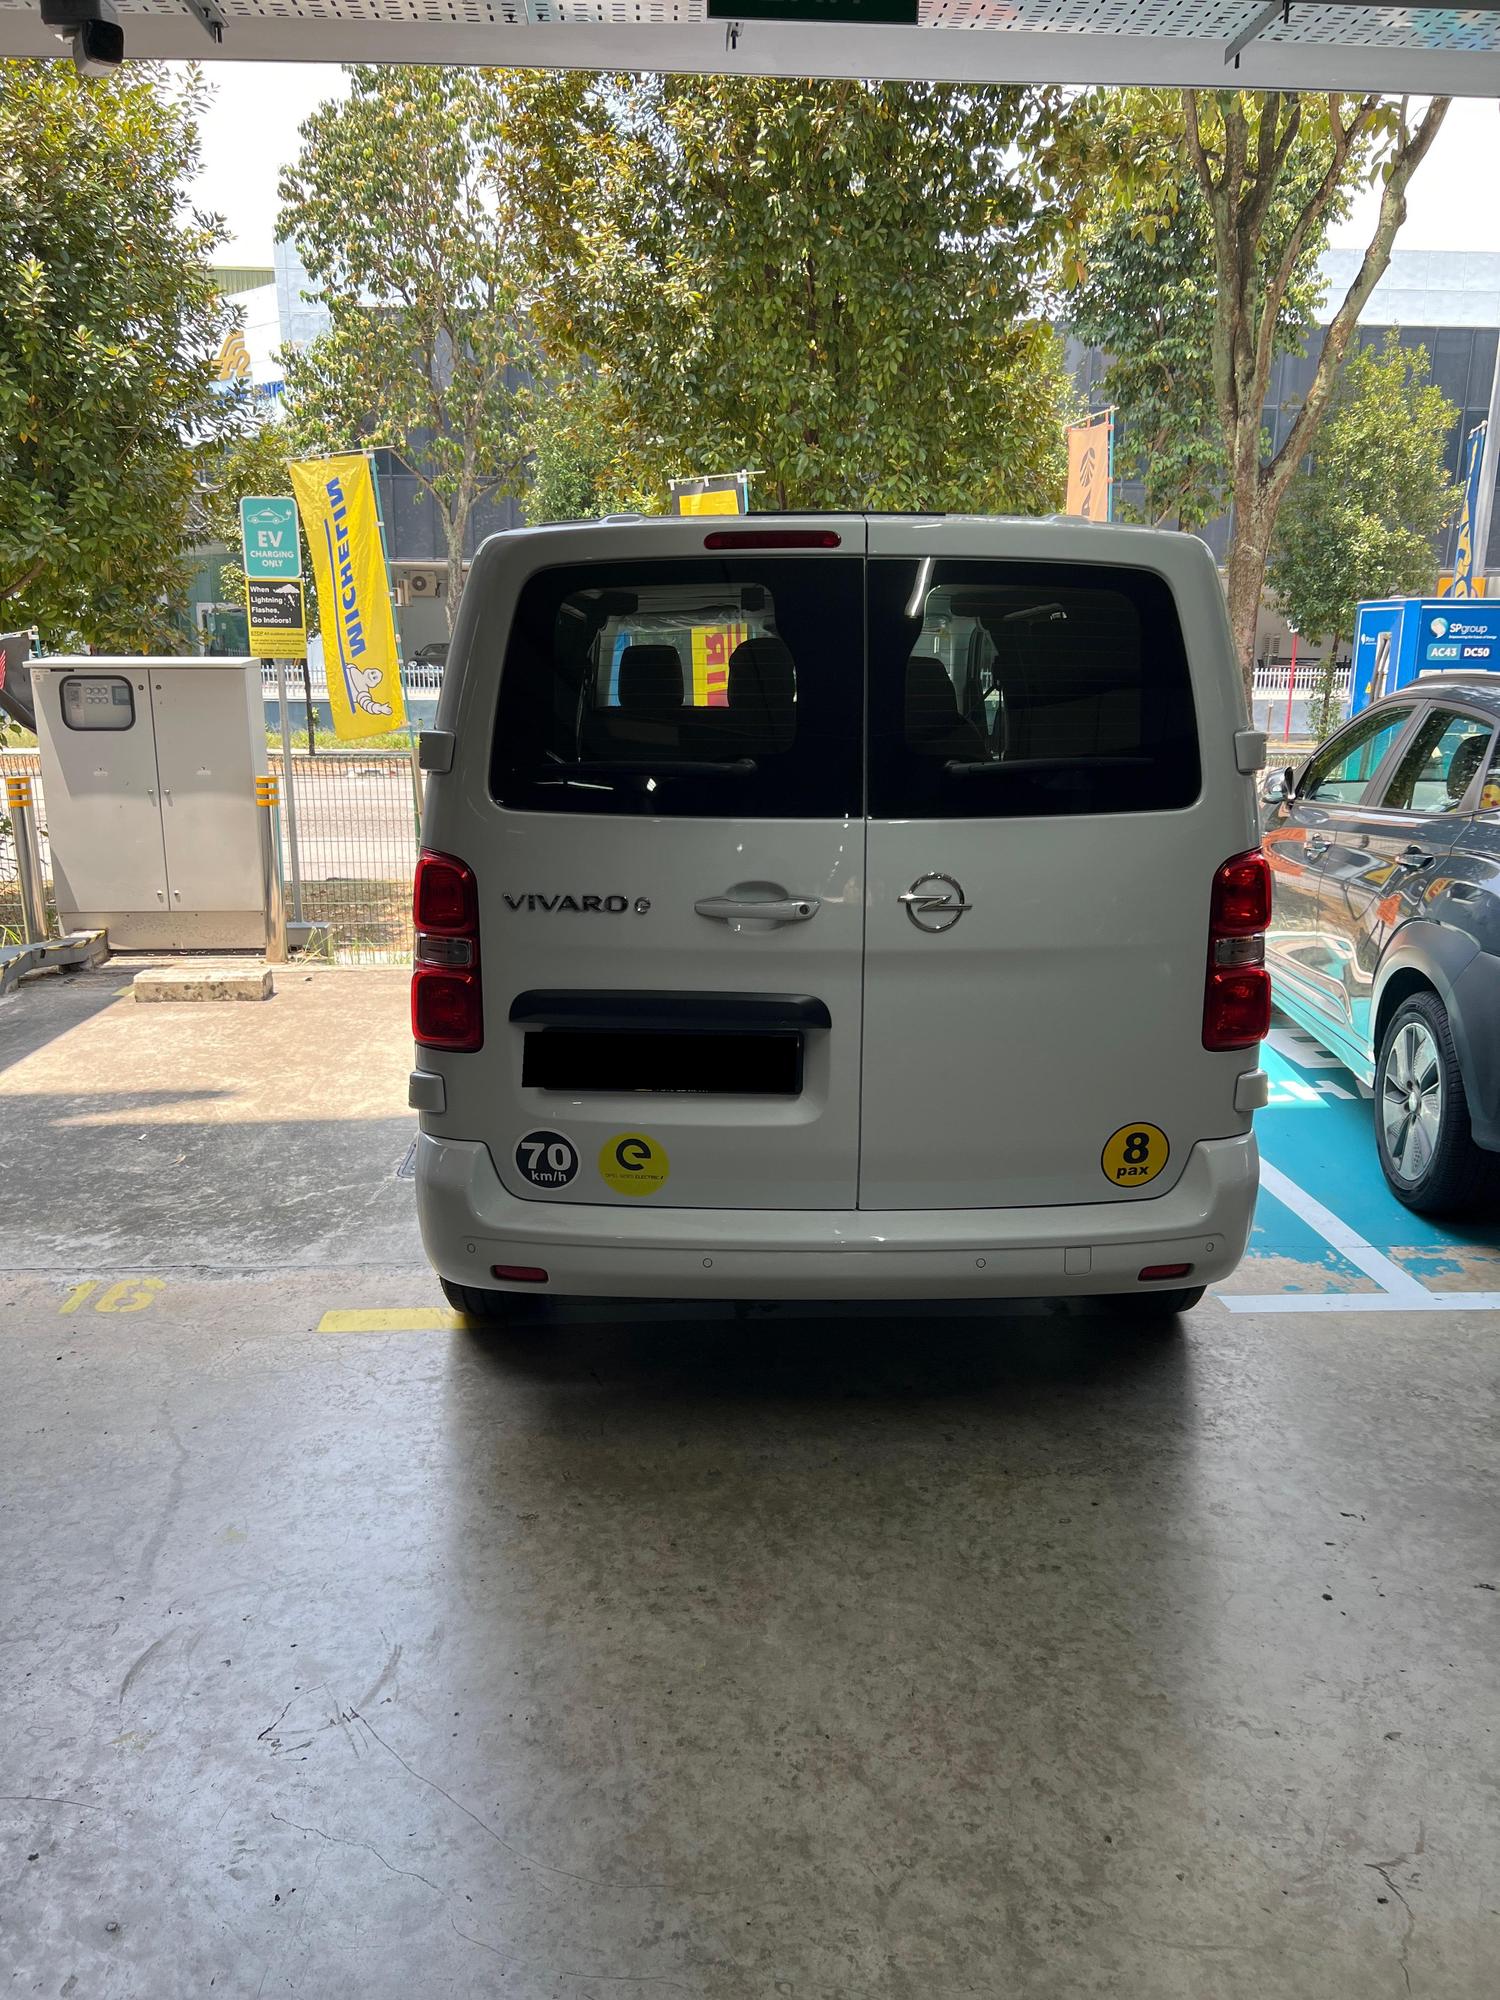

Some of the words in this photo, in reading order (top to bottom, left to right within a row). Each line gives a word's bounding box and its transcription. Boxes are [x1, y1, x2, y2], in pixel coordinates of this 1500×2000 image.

[258, 530, 283, 547] EV
[249, 550, 294, 559] CHARGING
[262, 559, 284, 568] ONLY
[250, 596, 283, 605] Lightning
[251, 606, 280, 614] Flashes,
[252, 616, 263, 624] Go
[263, 616, 292, 624] Indoors!
[1430, 647, 1458, 657] AC43
[1463, 647, 1490, 657] DC50
[503, 894, 629, 914] VIVARO
[1123, 1132, 1150, 1164] 8
[520, 1142, 572, 1171] 70
[531, 1170, 567, 1182] km/h
[1116, 1166, 1150, 1179] pax
[58, 1276, 166, 1314] 16
